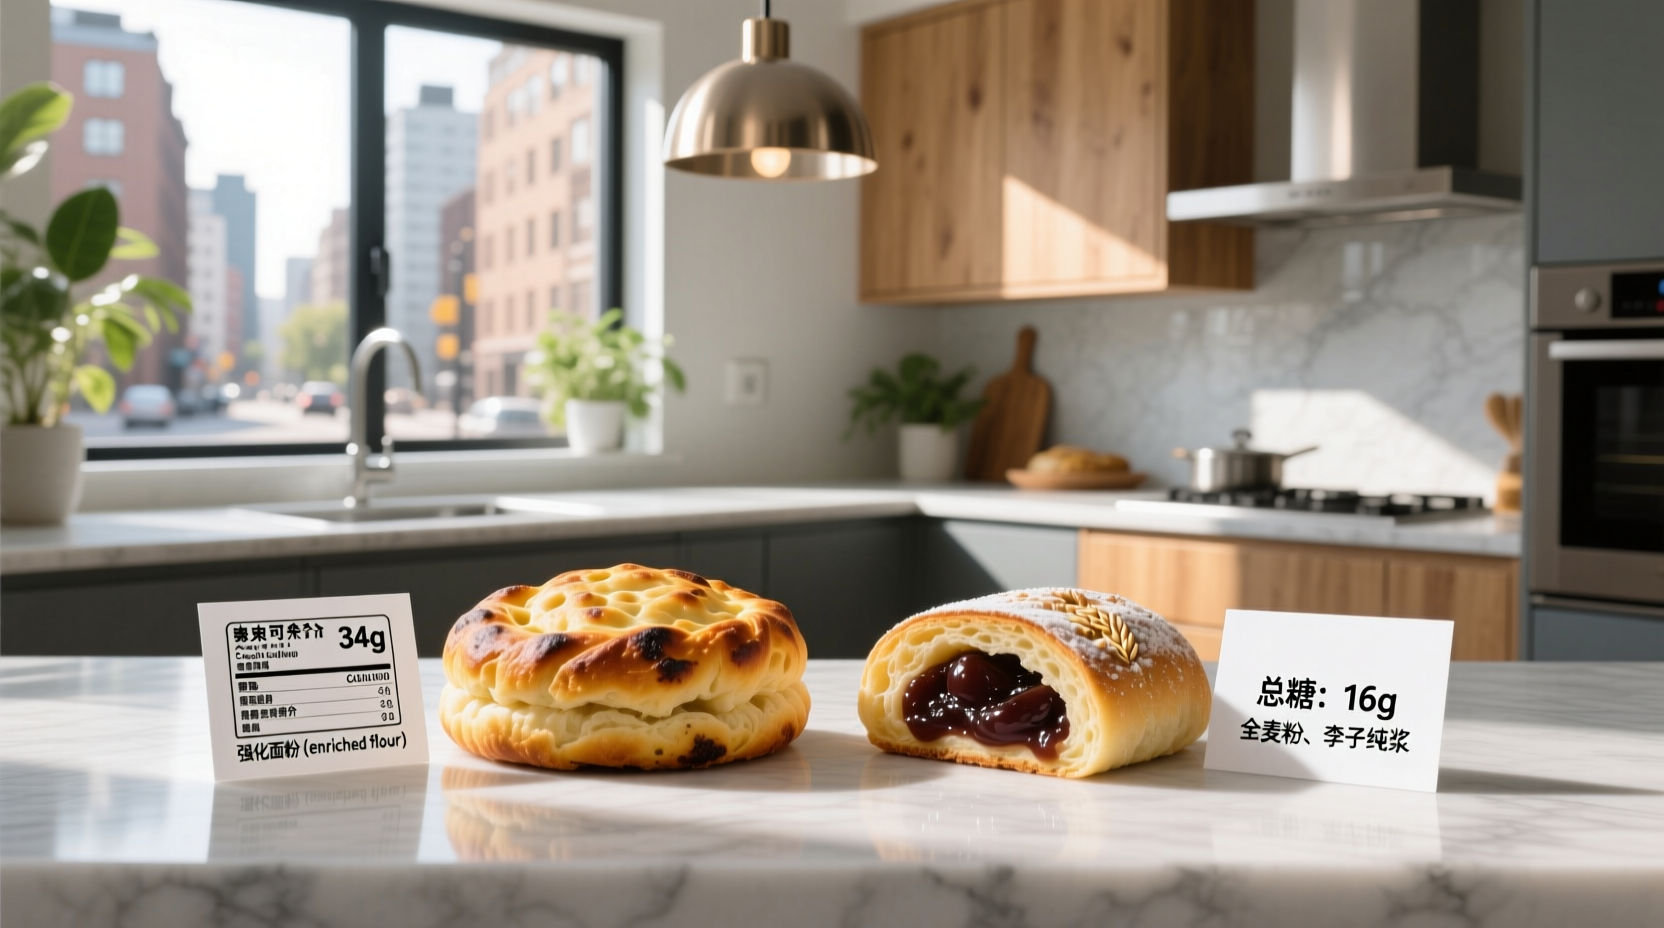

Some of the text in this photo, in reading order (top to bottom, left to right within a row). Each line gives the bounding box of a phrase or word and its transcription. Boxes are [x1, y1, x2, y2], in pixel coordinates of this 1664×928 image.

[338, 625, 386, 654] 34g
[236, 731, 407, 762] 强化面粉 (enriched flour)
[1239, 717, 1411, 753] 全麦粉、李子纯浆
